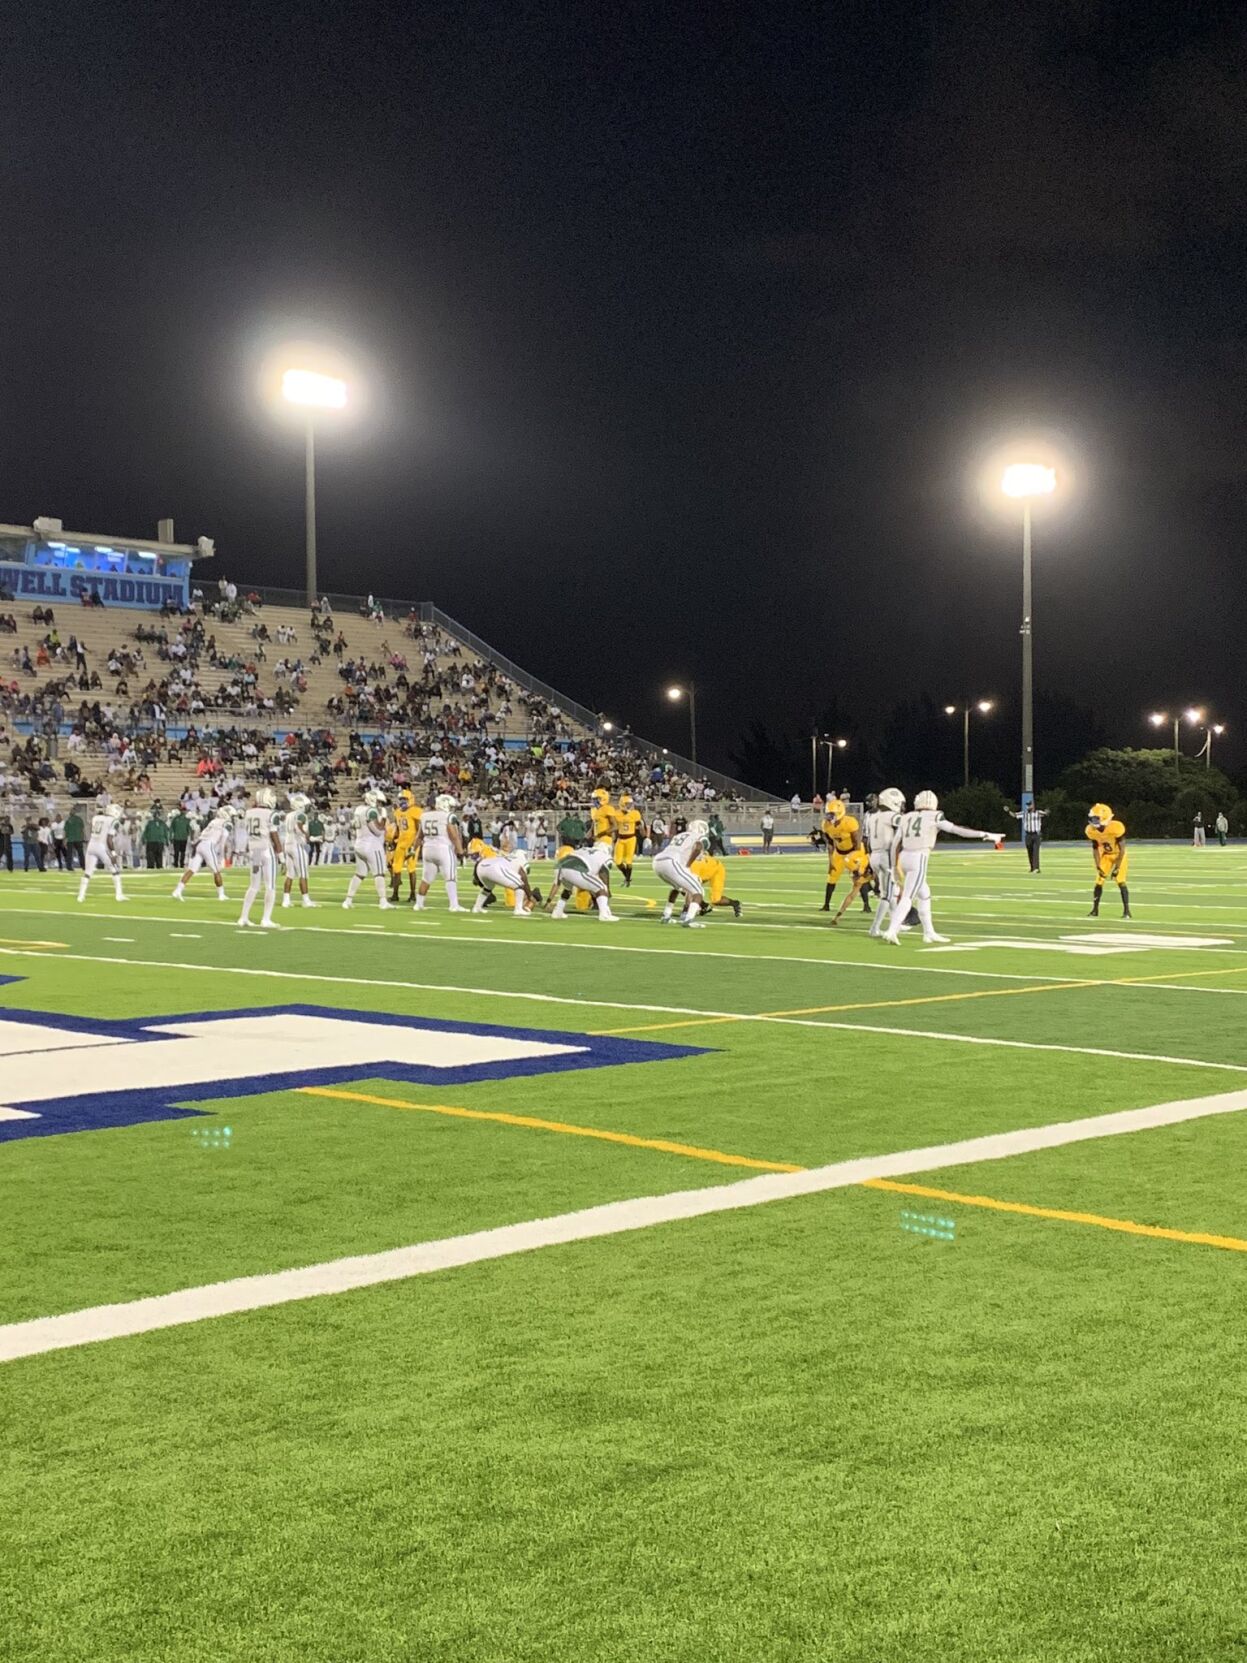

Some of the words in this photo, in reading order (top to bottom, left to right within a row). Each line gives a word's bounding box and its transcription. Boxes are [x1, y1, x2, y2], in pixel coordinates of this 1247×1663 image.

[70, 575, 184, 608] STADIUM
[424, 820, 439, 836] 55
[905, 817, 922, 837] 14
